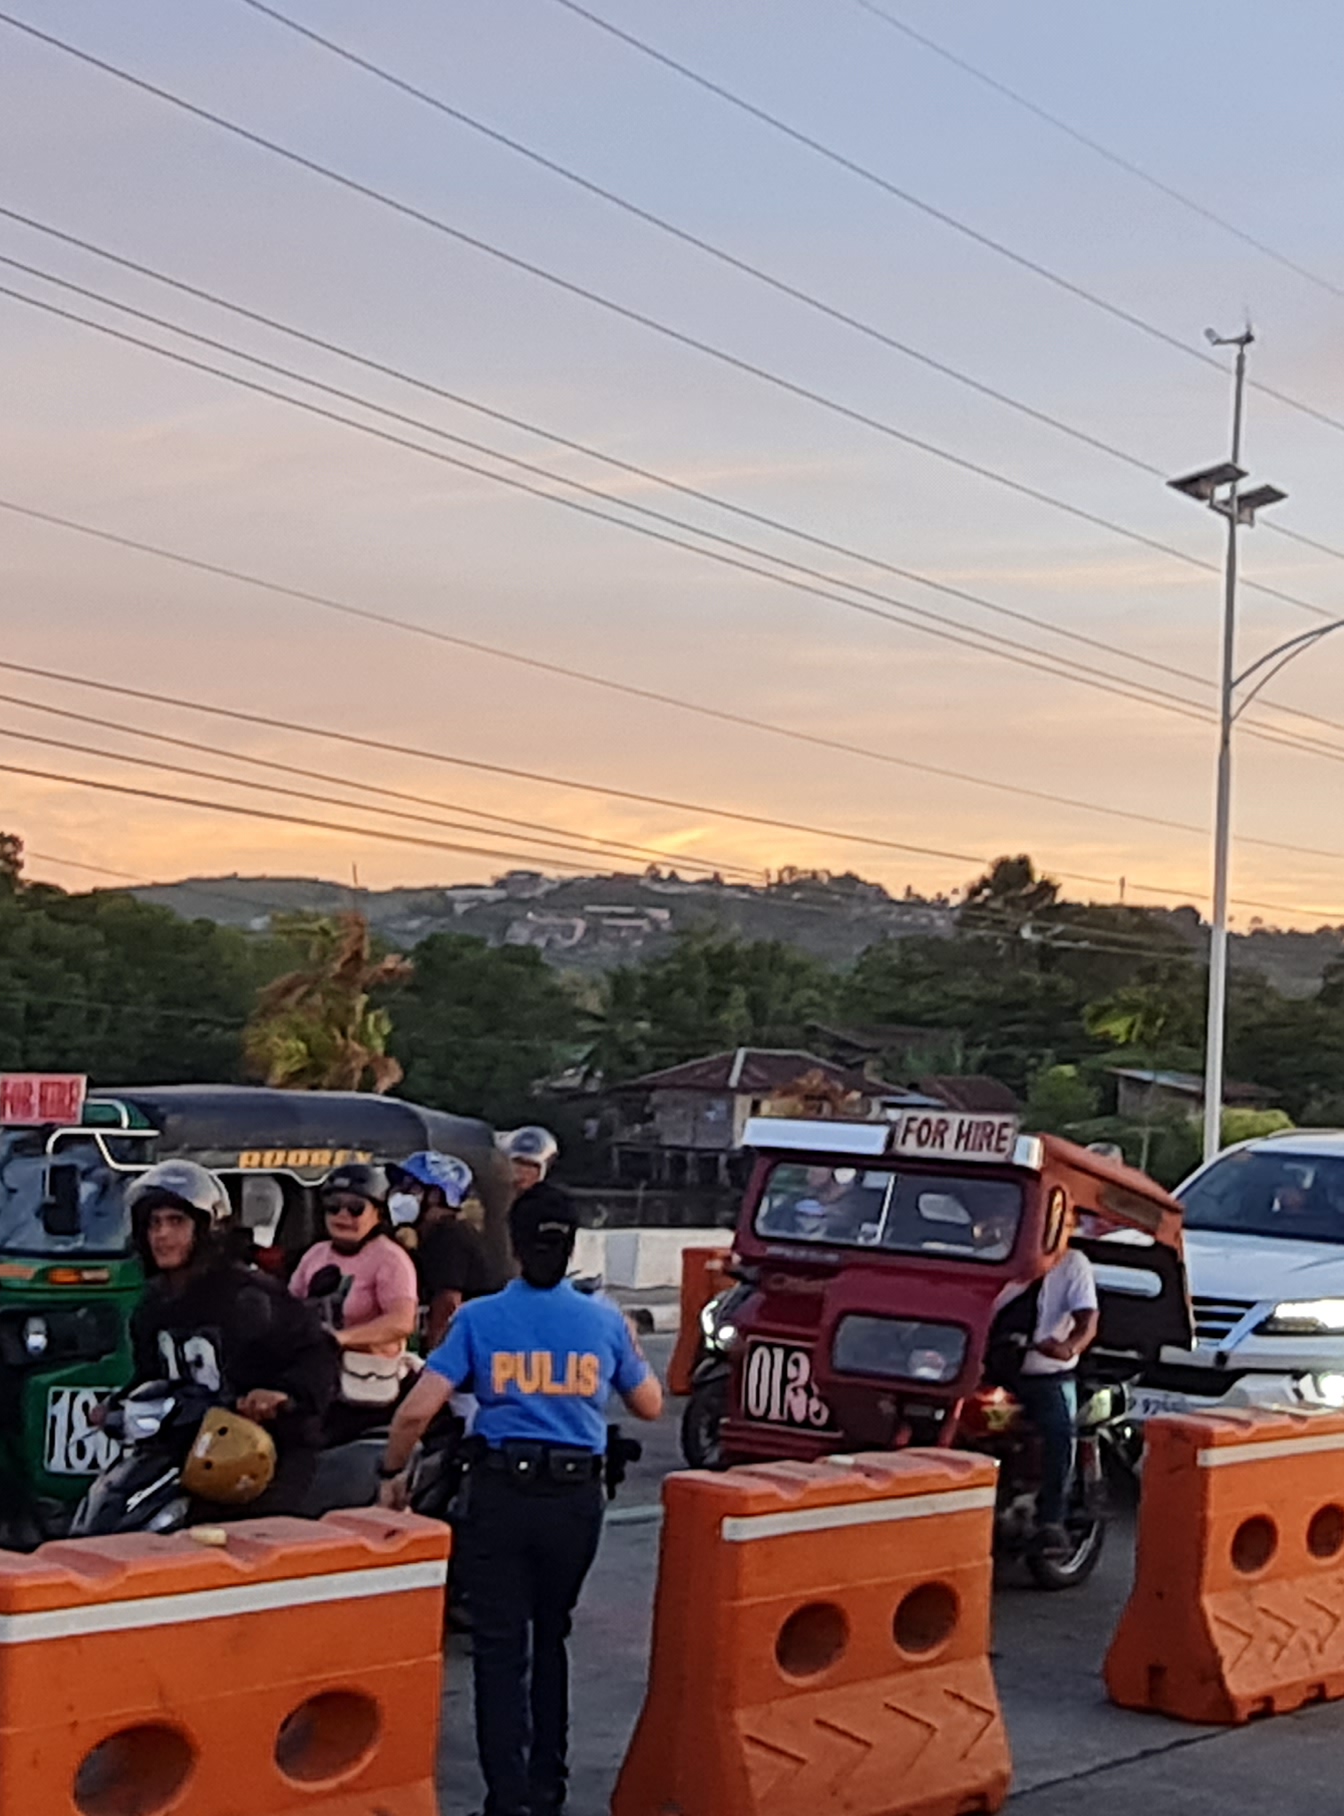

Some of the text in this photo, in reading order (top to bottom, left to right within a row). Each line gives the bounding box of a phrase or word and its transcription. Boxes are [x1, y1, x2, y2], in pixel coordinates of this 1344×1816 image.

[0, 1080, 81, 1119] FOR HIRE
[901, 1116, 1012, 1153] FOR HIRE
[492, 1351, 599, 1397] PULIS
